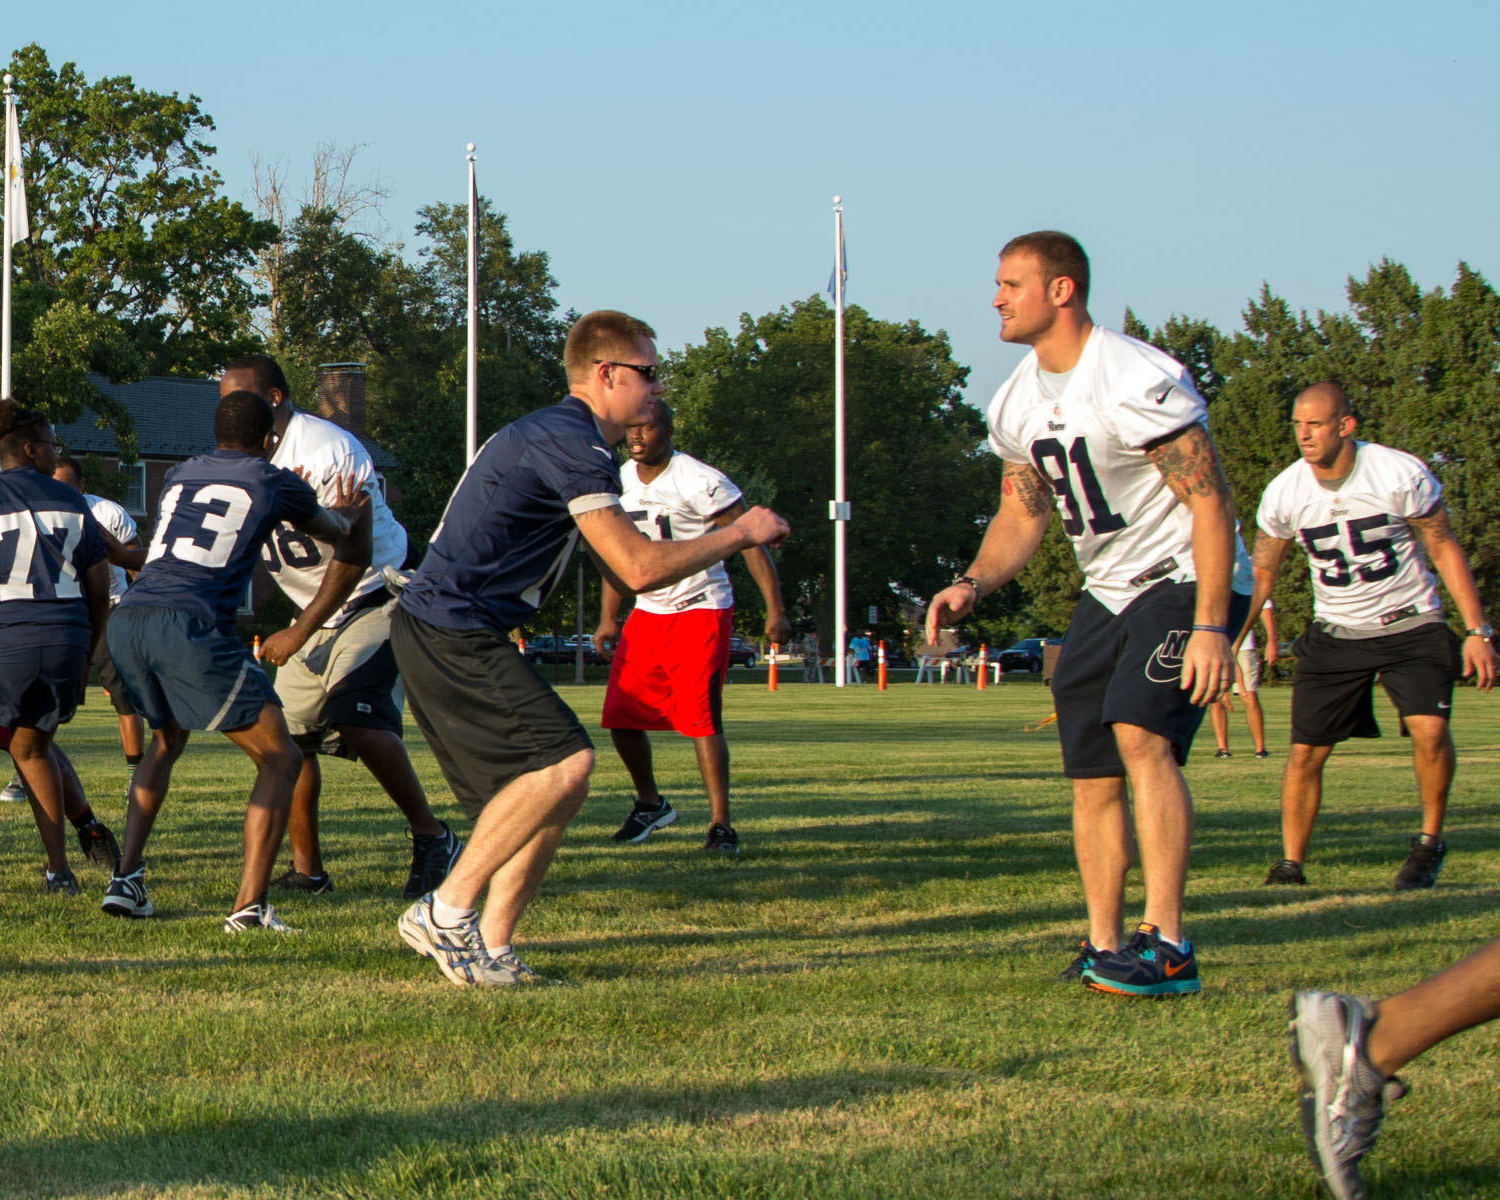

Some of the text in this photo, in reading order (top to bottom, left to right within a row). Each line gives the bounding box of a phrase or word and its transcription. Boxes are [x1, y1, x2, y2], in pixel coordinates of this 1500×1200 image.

[145, 484, 252, 568] 13
[1030, 436, 1128, 536] 91
[1300, 513, 1399, 587] 55
